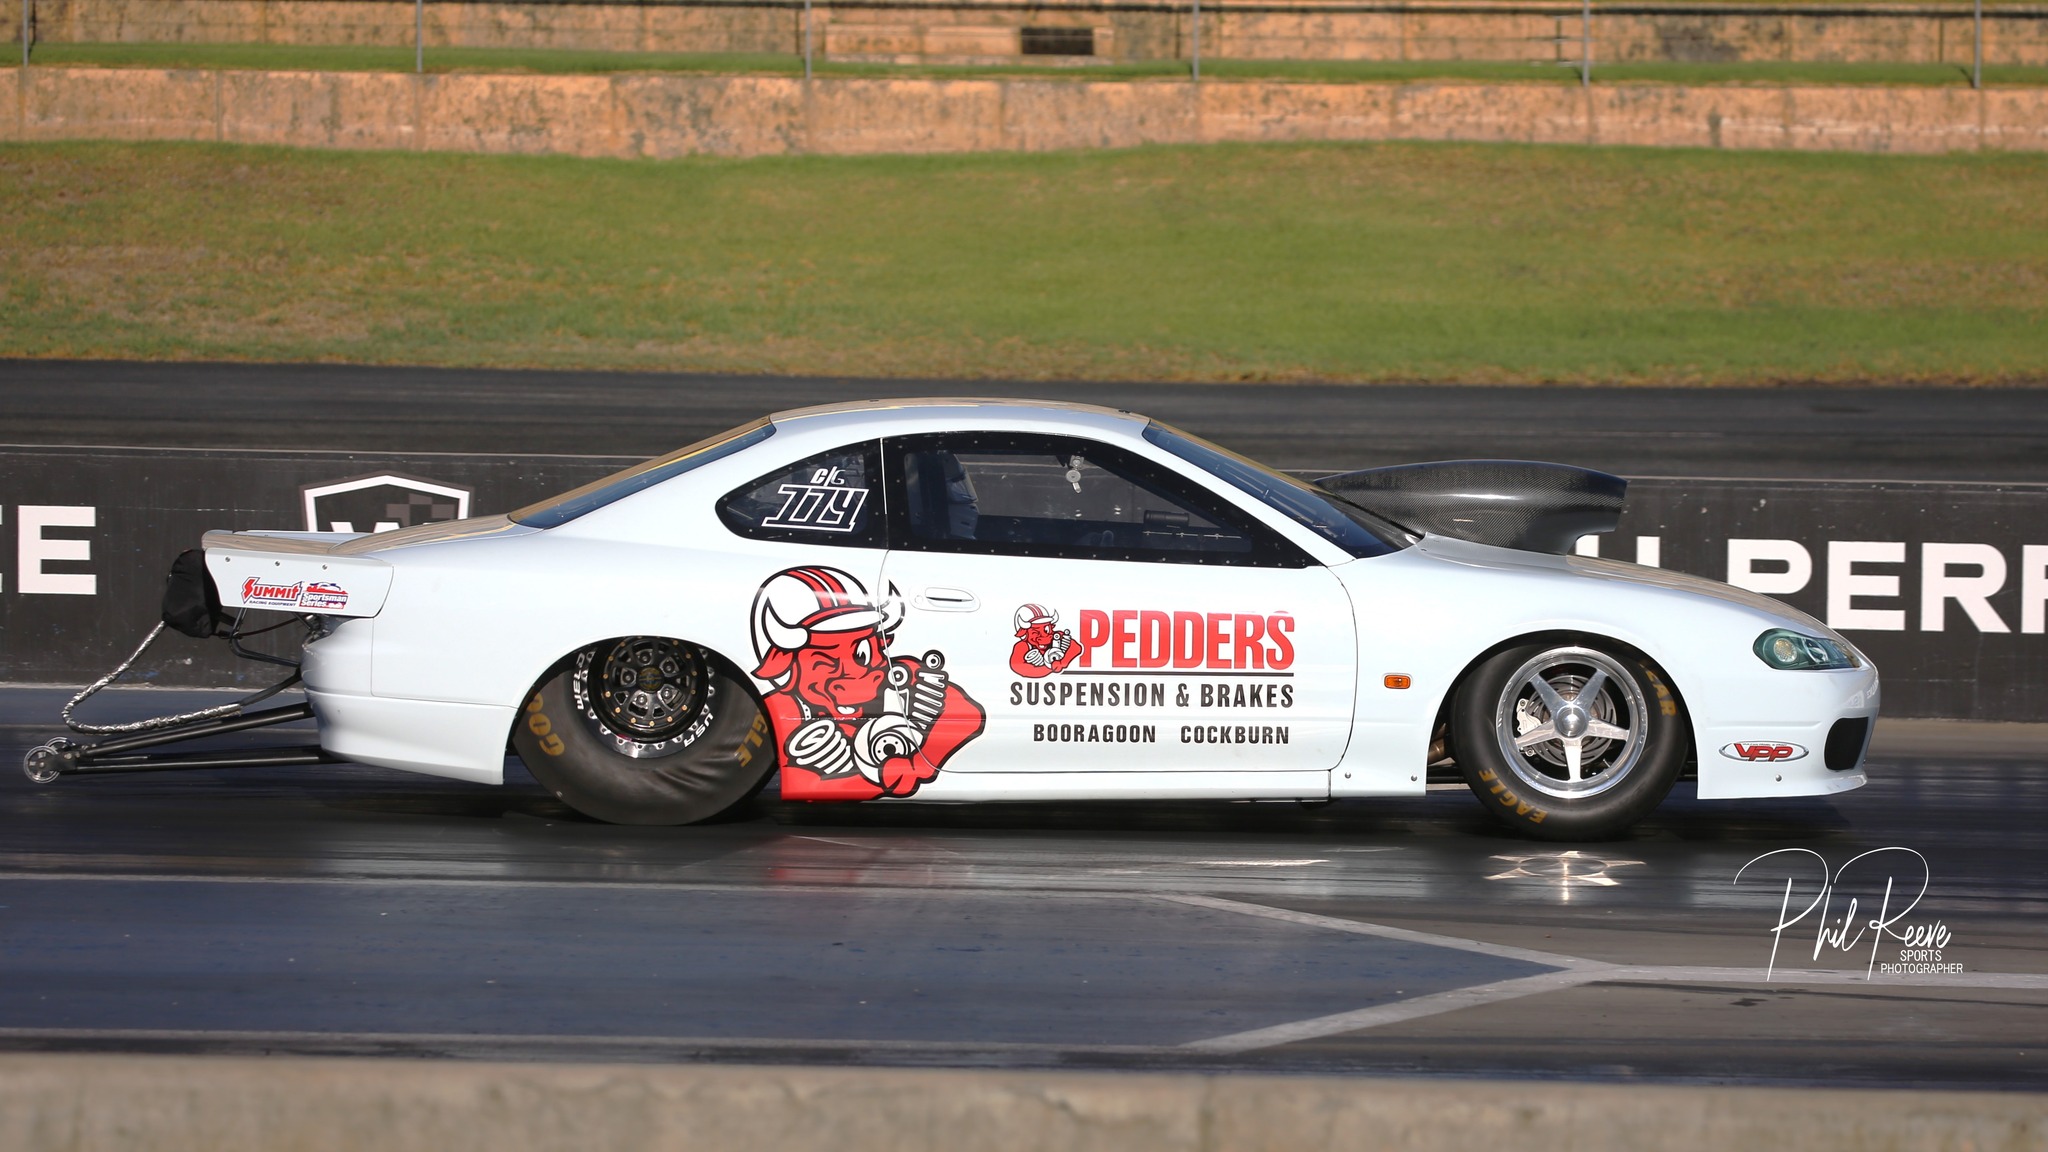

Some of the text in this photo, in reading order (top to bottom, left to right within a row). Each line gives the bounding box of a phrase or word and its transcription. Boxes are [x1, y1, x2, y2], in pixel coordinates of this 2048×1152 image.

[0, 504, 97, 595] E
[303, 593, 347, 602] Sportsman
[1079, 609, 1295, 670] PEDDERS
[573, 652, 585, 710] WELD
[1010, 681, 1294, 708] SUSPENSION & BRAKES
[1638, 662, 1676, 717] EAR
[683, 712, 714, 748] USA
[733, 709, 768, 767] GLE
[1034, 724, 1289, 744] BOORAGOON COCKBURN
[1478, 767, 1548, 823] EAGLE
